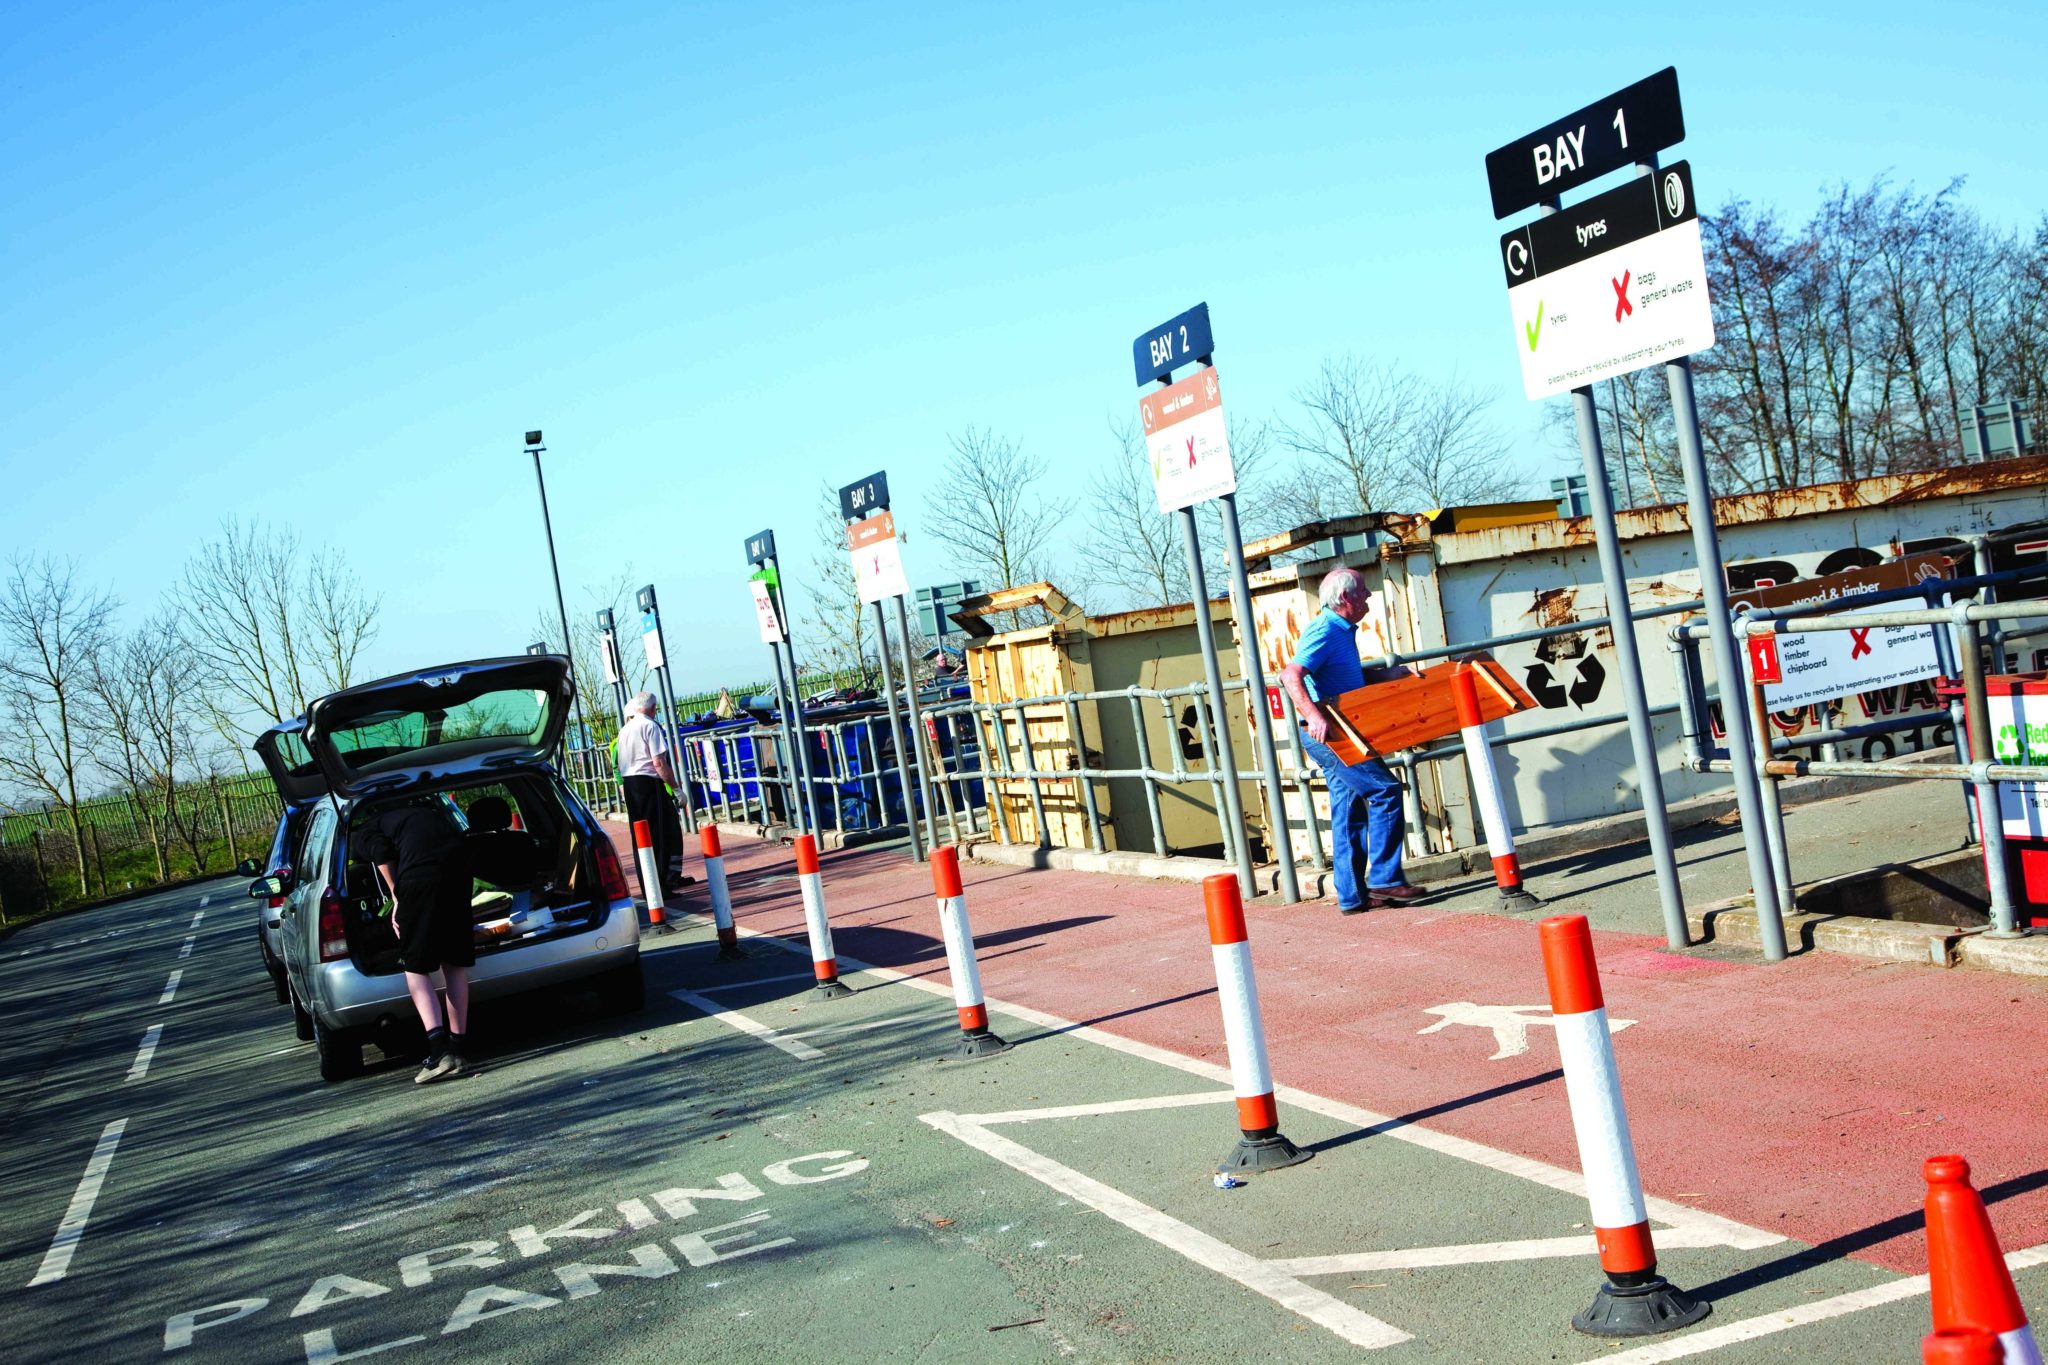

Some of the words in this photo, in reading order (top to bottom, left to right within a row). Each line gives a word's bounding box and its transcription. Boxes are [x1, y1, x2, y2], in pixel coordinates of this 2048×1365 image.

[1533, 125, 1586, 185] BAY
[1613, 108, 1628, 150] 1
[1576, 217, 1608, 248] tyres
[1637, 271, 1657, 286] bags
[1641, 282, 1669, 309] general
[1671, 279, 1693, 295] waste
[1551, 311, 1568, 326] tyres
[1150, 331, 1173, 368] BAY
[1180, 325, 1190, 354] 2
[851, 486, 866, 509] BAY
[868, 482, 875, 502] 3
[1792, 589, 1827, 606] wood
[1829, 587, 1840, 601] &
[1842, 581, 1880, 598] timber
[1782, 635, 1806, 649] wood
[1886, 630, 1918, 648] general
[1758, 648, 1769, 670] 1
[1784, 649, 1810, 662] timber
[1786, 659, 1828, 675] chipboard
[1779, 692, 1794, 705] help
[1796, 691, 1804, 700] us
[1804, 689, 1811, 698] to
[1812, 685, 1835, 698] recycle
[1835, 682, 1845, 692] by
[1845, 676, 1882, 691] separating
[1882, 672, 1898, 682] your
[1899, 667, 1919, 677] wood
[1920, 665, 1927, 673] &
[1271, 694, 1280, 710] 2
[163, 1148, 870, 1353] PARKING
[300, 1208, 796, 1365] LANE
